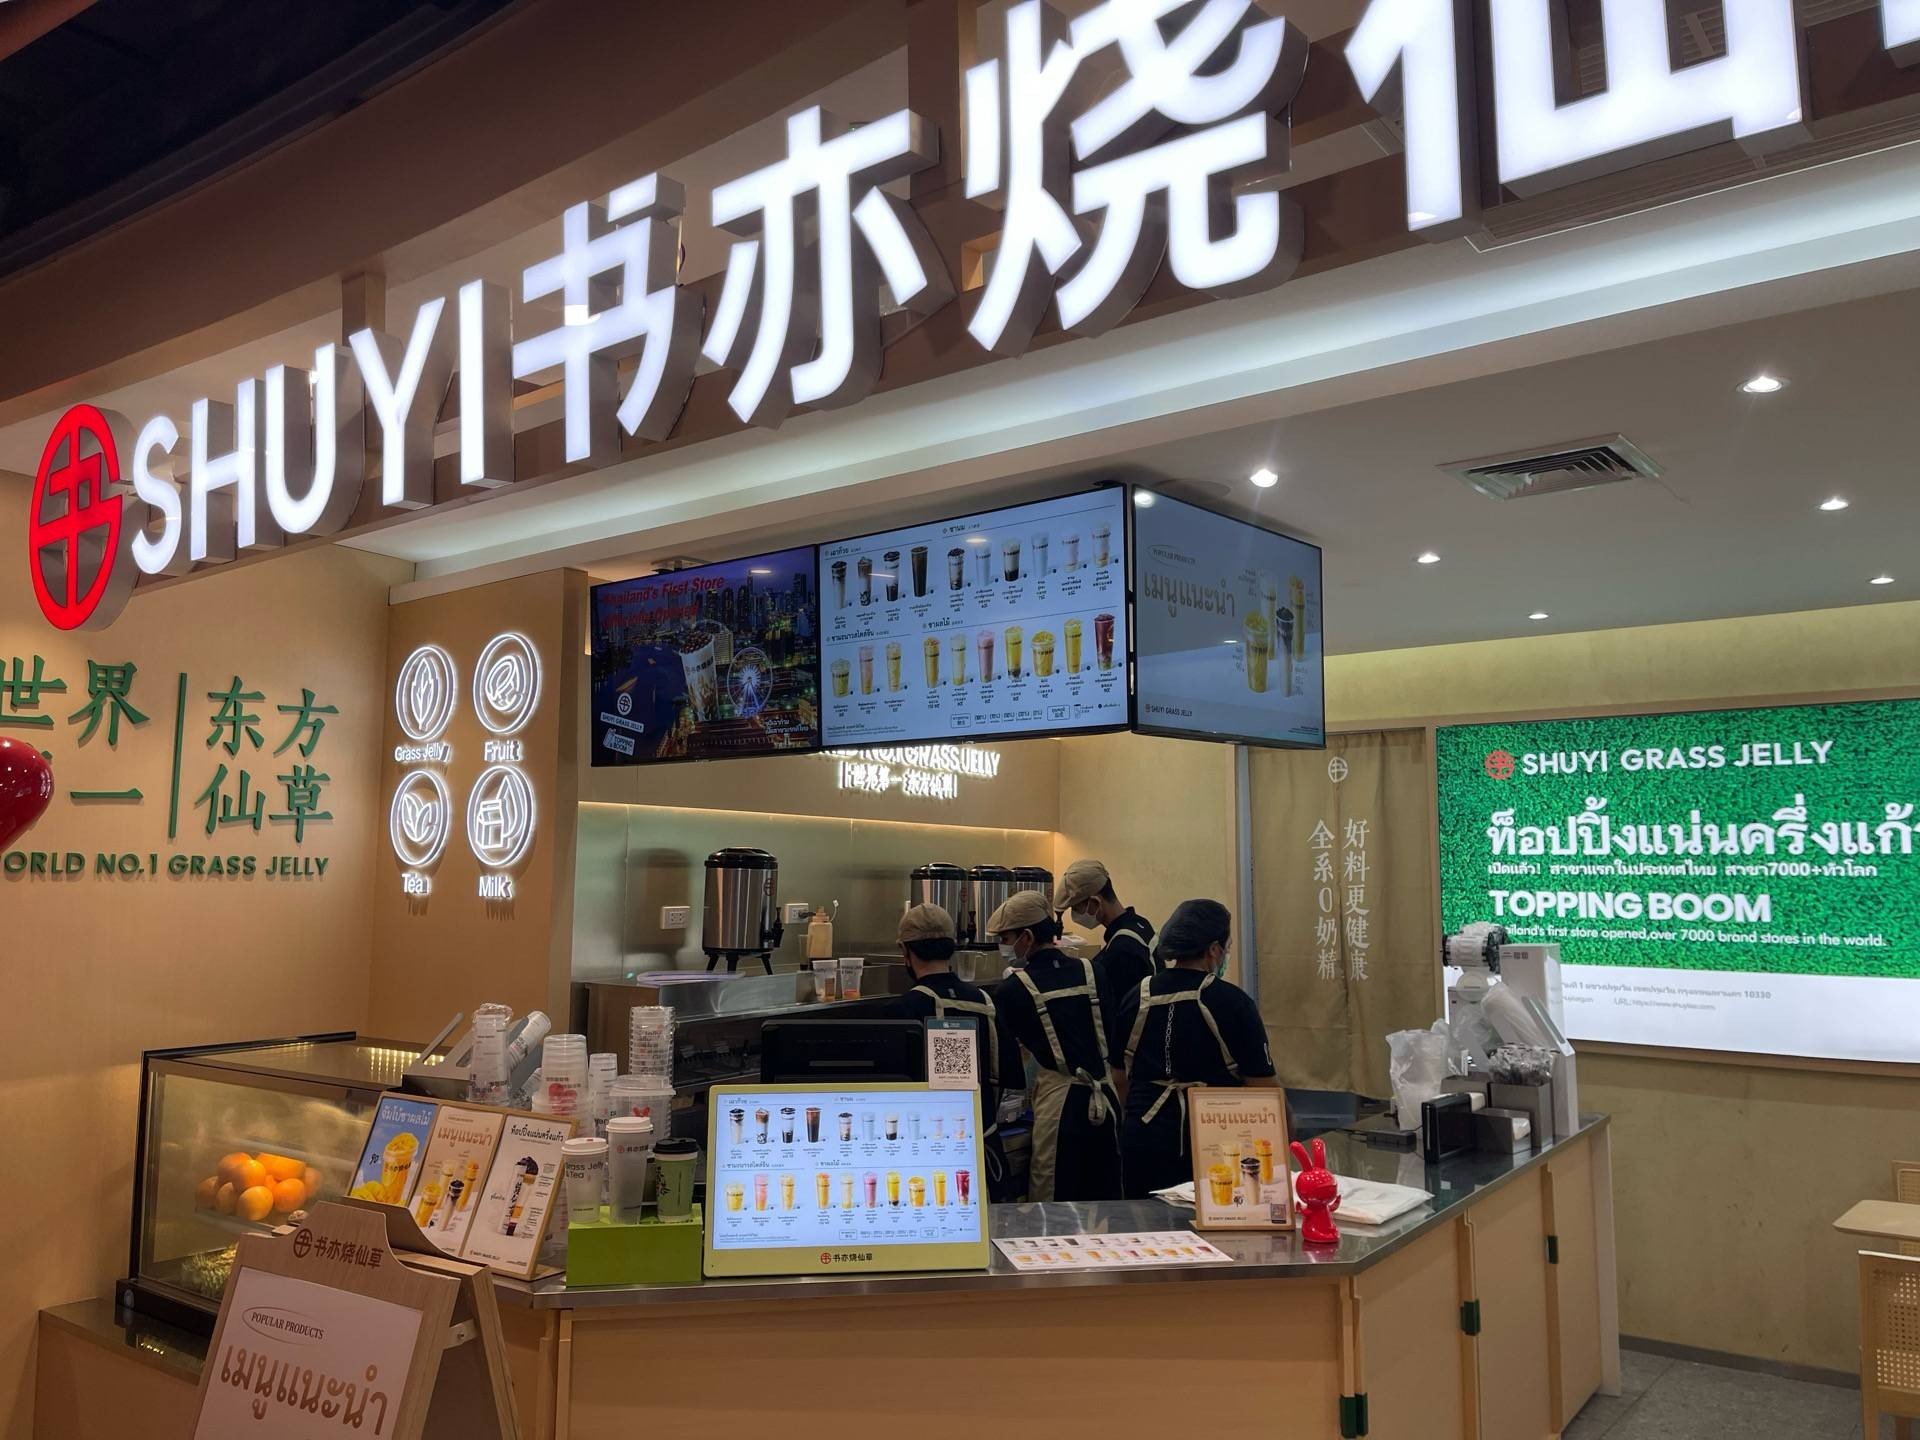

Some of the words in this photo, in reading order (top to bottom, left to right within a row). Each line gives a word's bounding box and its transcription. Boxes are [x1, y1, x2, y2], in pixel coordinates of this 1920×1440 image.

[132, 282, 485, 575] SHUYI
[512, 0, 1920, 464] 书亦烧仙
[692, 576, 725, 592] Store
[1144, 571, 1235, 618] เมนูแนะนำ
[0, 654, 151, 747] 世界
[206, 675, 340, 758] 东方
[394, 744, 423, 763] Grass
[422, 740, 446, 763] Jelly
[483, 740, 518, 762] Fruit
[1521, 749, 1609, 776] SHUYI
[1620, 745, 1726, 771] GRASS
[1733, 740, 1834, 767] JELLY
[194, 762, 335, 844] 仙草
[1486, 793, 1920, 857] ท็อปปิ้งแน่นครึ่งแก้
[0, 850, 85, 874] ORLD
[96, 852, 159, 876] NO.1
[168, 854, 256, 876] GRASS
[264, 856, 329, 877] JELLY
[1550, 858, 1717, 876] สาขาแรกในประเทศไทย
[401, 873, 427, 896] Tea
[478, 875, 511, 898] Milk
[1342, 817, 1371, 982] 好料更健康
[1488, 889, 1643, 920] TOPPING
[1648, 891, 1772, 923] BOOM
[1503, 923, 1545, 937] ailand's
[1547, 924, 1569, 937] first
[1570, 926, 1599, 938] store
[1680, 929, 1715, 943] 7000
[1717, 930, 1757, 944] brand
[1760, 931, 1800, 945] stores
[1802, 933, 1815, 945] in
[1818, 931, 1840, 946] the
[1843, 933, 1887, 947] world.
[1200, 1106, 1277, 1130] เมนูแนะนำ
[437, 1126, 493, 1148] เมนูแนะนำ
[313, 1237, 384, 1270] 书亦烧仙草
[251, 1311, 285, 1332] POPULAR
[284, 1318, 325, 1341] PRODUCTS
[220, 1344, 388, 1437] เมนูแนะนำ
